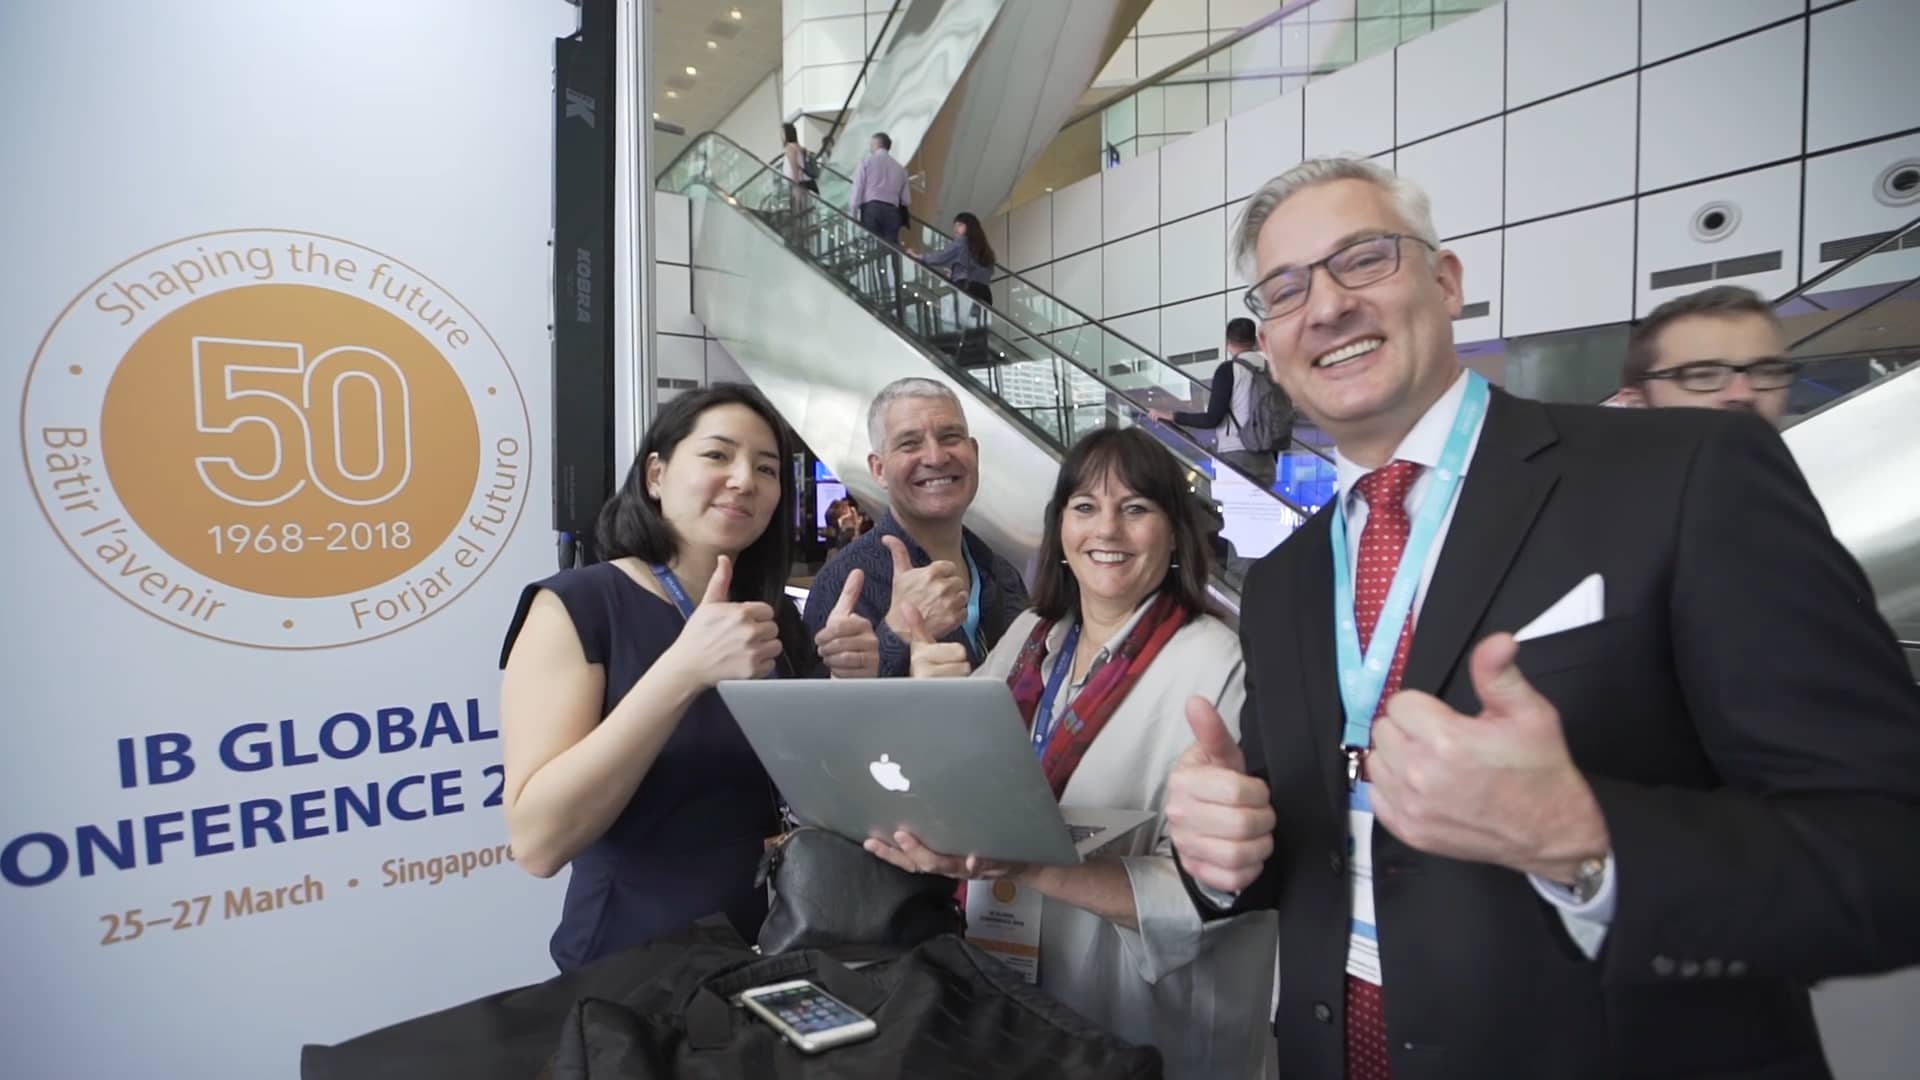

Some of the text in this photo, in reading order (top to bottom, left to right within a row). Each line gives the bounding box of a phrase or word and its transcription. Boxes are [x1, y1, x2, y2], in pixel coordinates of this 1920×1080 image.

[95, 242, 470, 350] Shaping the future
[575, 247, 591, 324] KOBRA
[42, 427, 99, 514] Bâtir
[192, 336, 413, 507] 50
[350, 436, 519, 630] Forjar el futuro
[117, 698, 498, 789] IB GLOBAL
[0, 769, 465, 888] ONFERENCE
[223, 874, 323, 920] March
